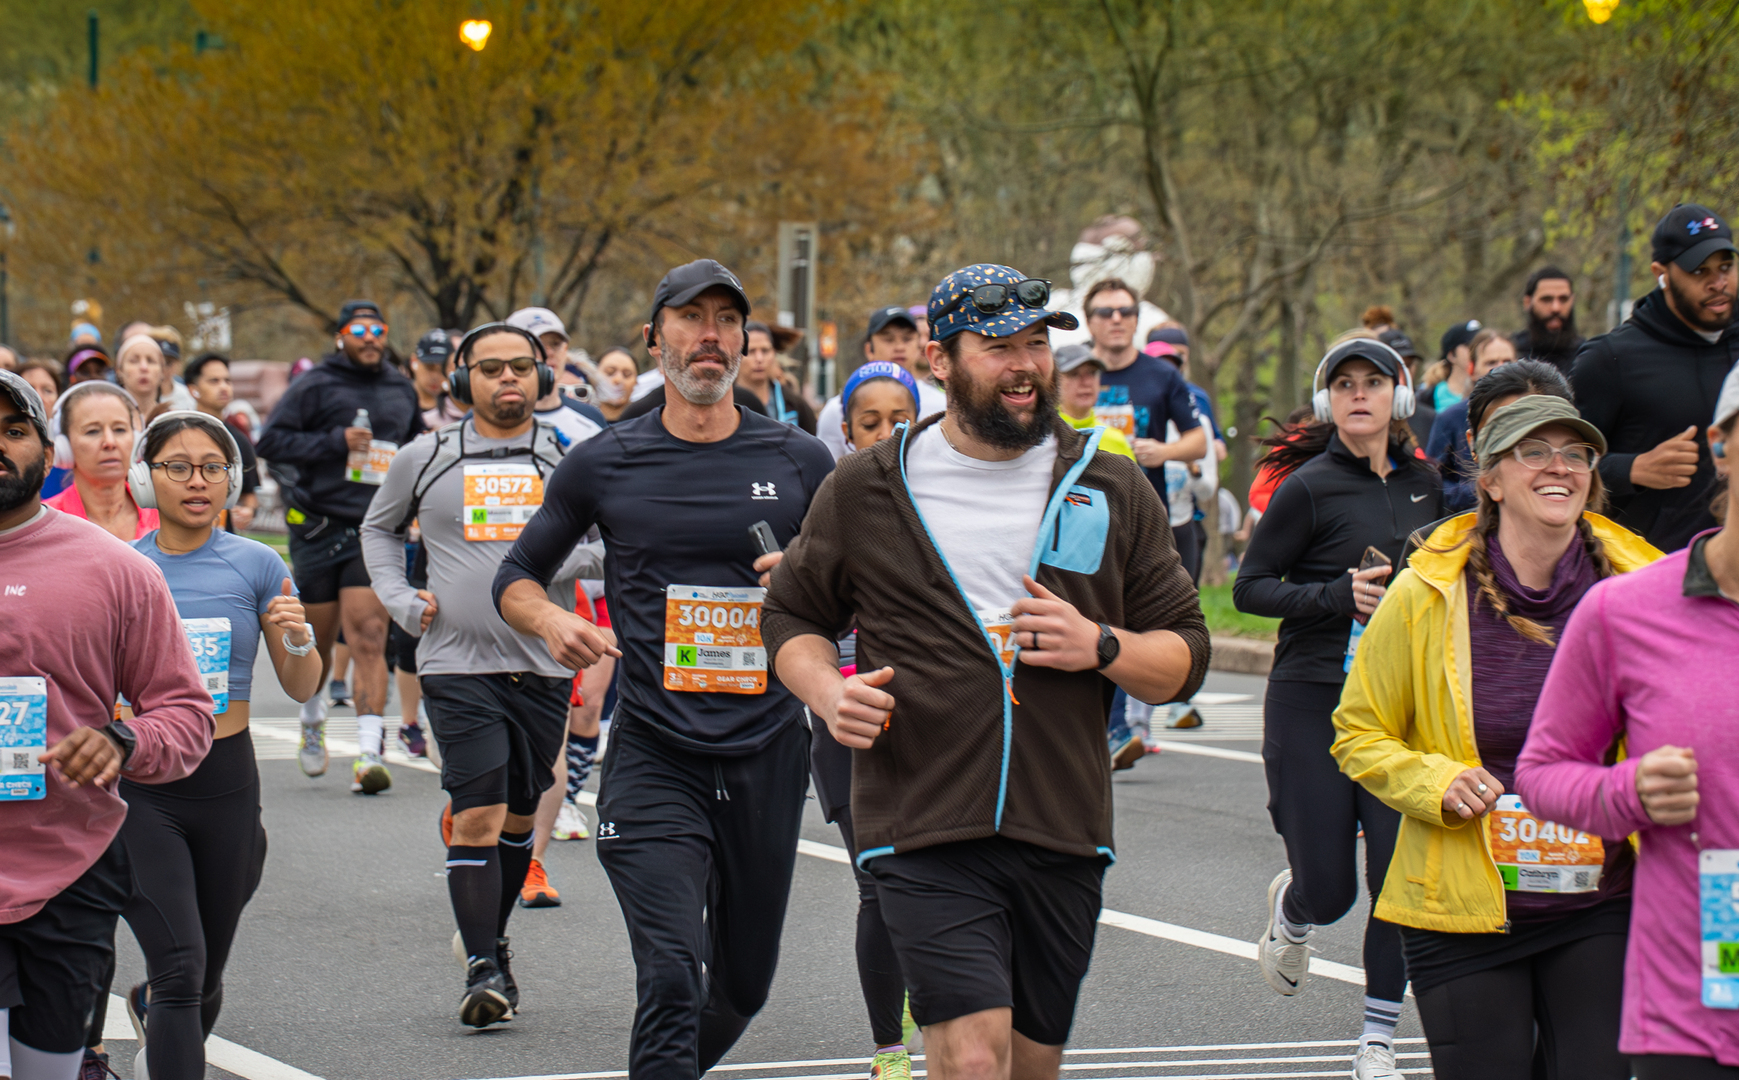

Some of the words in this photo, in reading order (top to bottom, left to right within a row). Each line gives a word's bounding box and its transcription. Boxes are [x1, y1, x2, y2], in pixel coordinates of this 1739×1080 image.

[475, 477, 532, 494] 30572
[474, 512, 484, 521] M
[678, 604, 758, 629] 30004
[696, 634, 713, 644] 10K
[190, 636, 219, 657] 35
[697, 648, 731, 659] James
[680, 649, 691, 663] K
